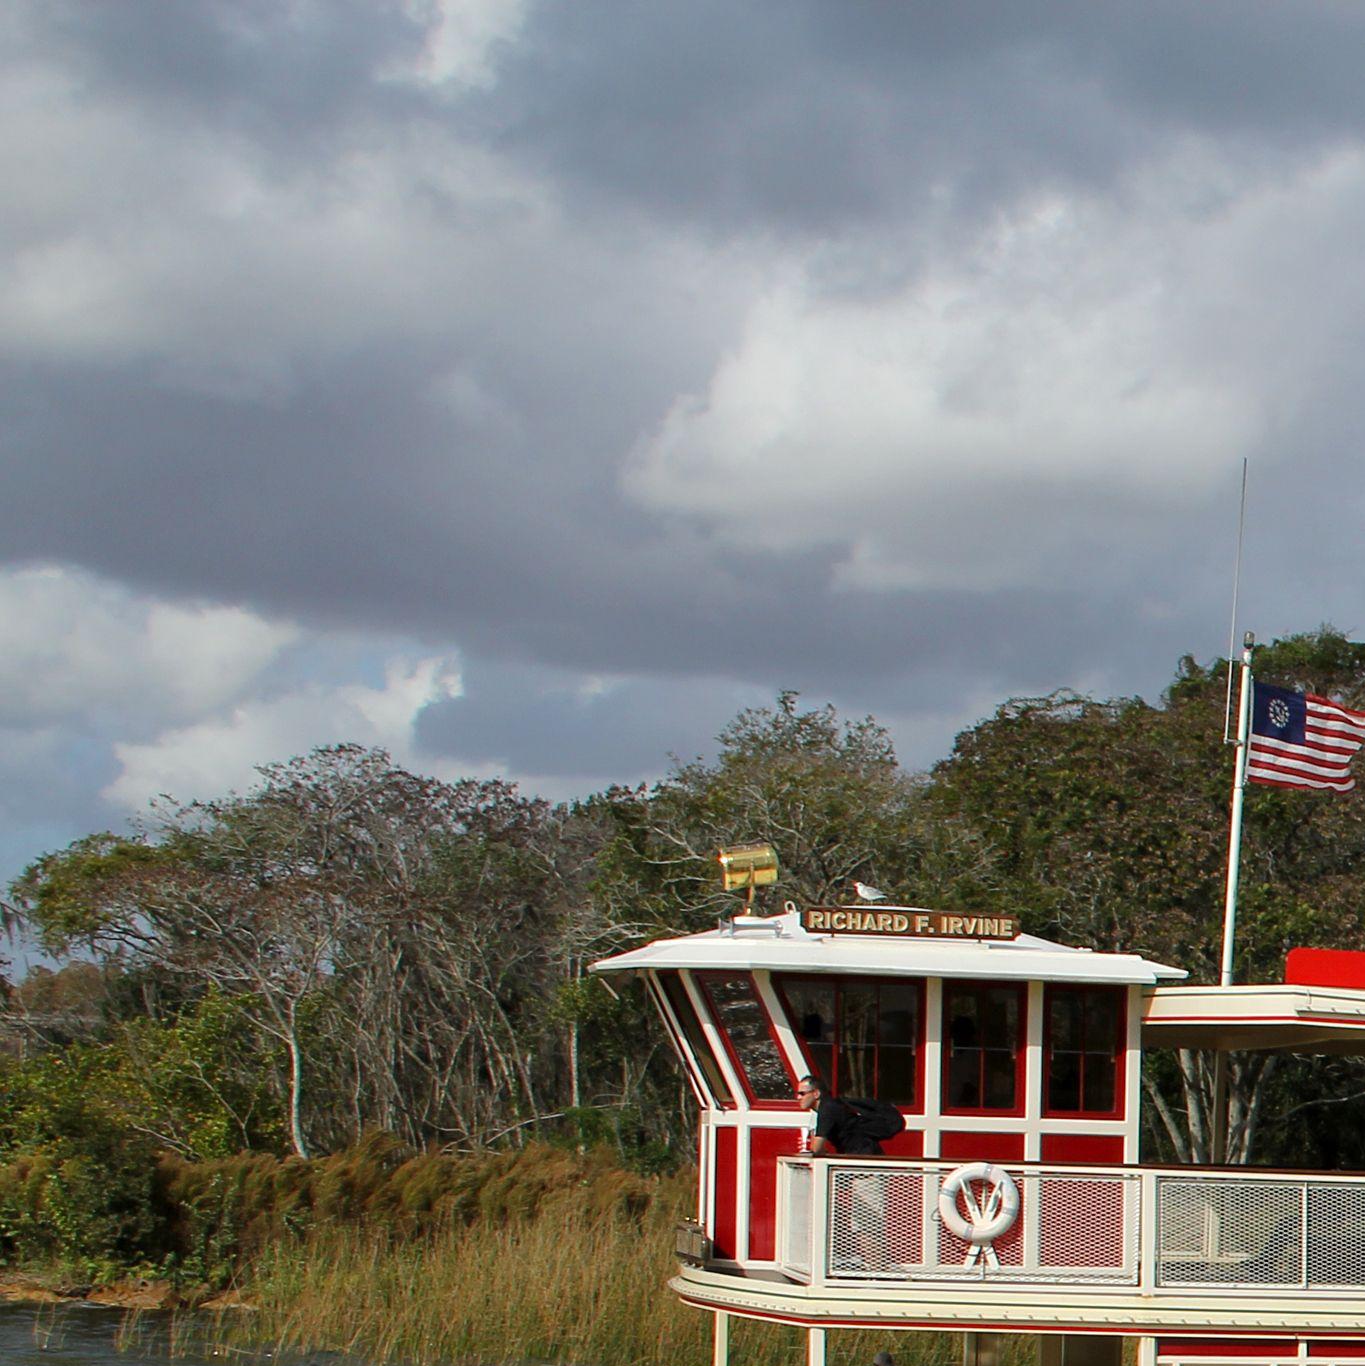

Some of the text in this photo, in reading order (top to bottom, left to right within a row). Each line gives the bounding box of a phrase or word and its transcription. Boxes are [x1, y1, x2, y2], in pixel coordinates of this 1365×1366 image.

[808, 910, 1013, 937] RICHARD F. IRVINE
